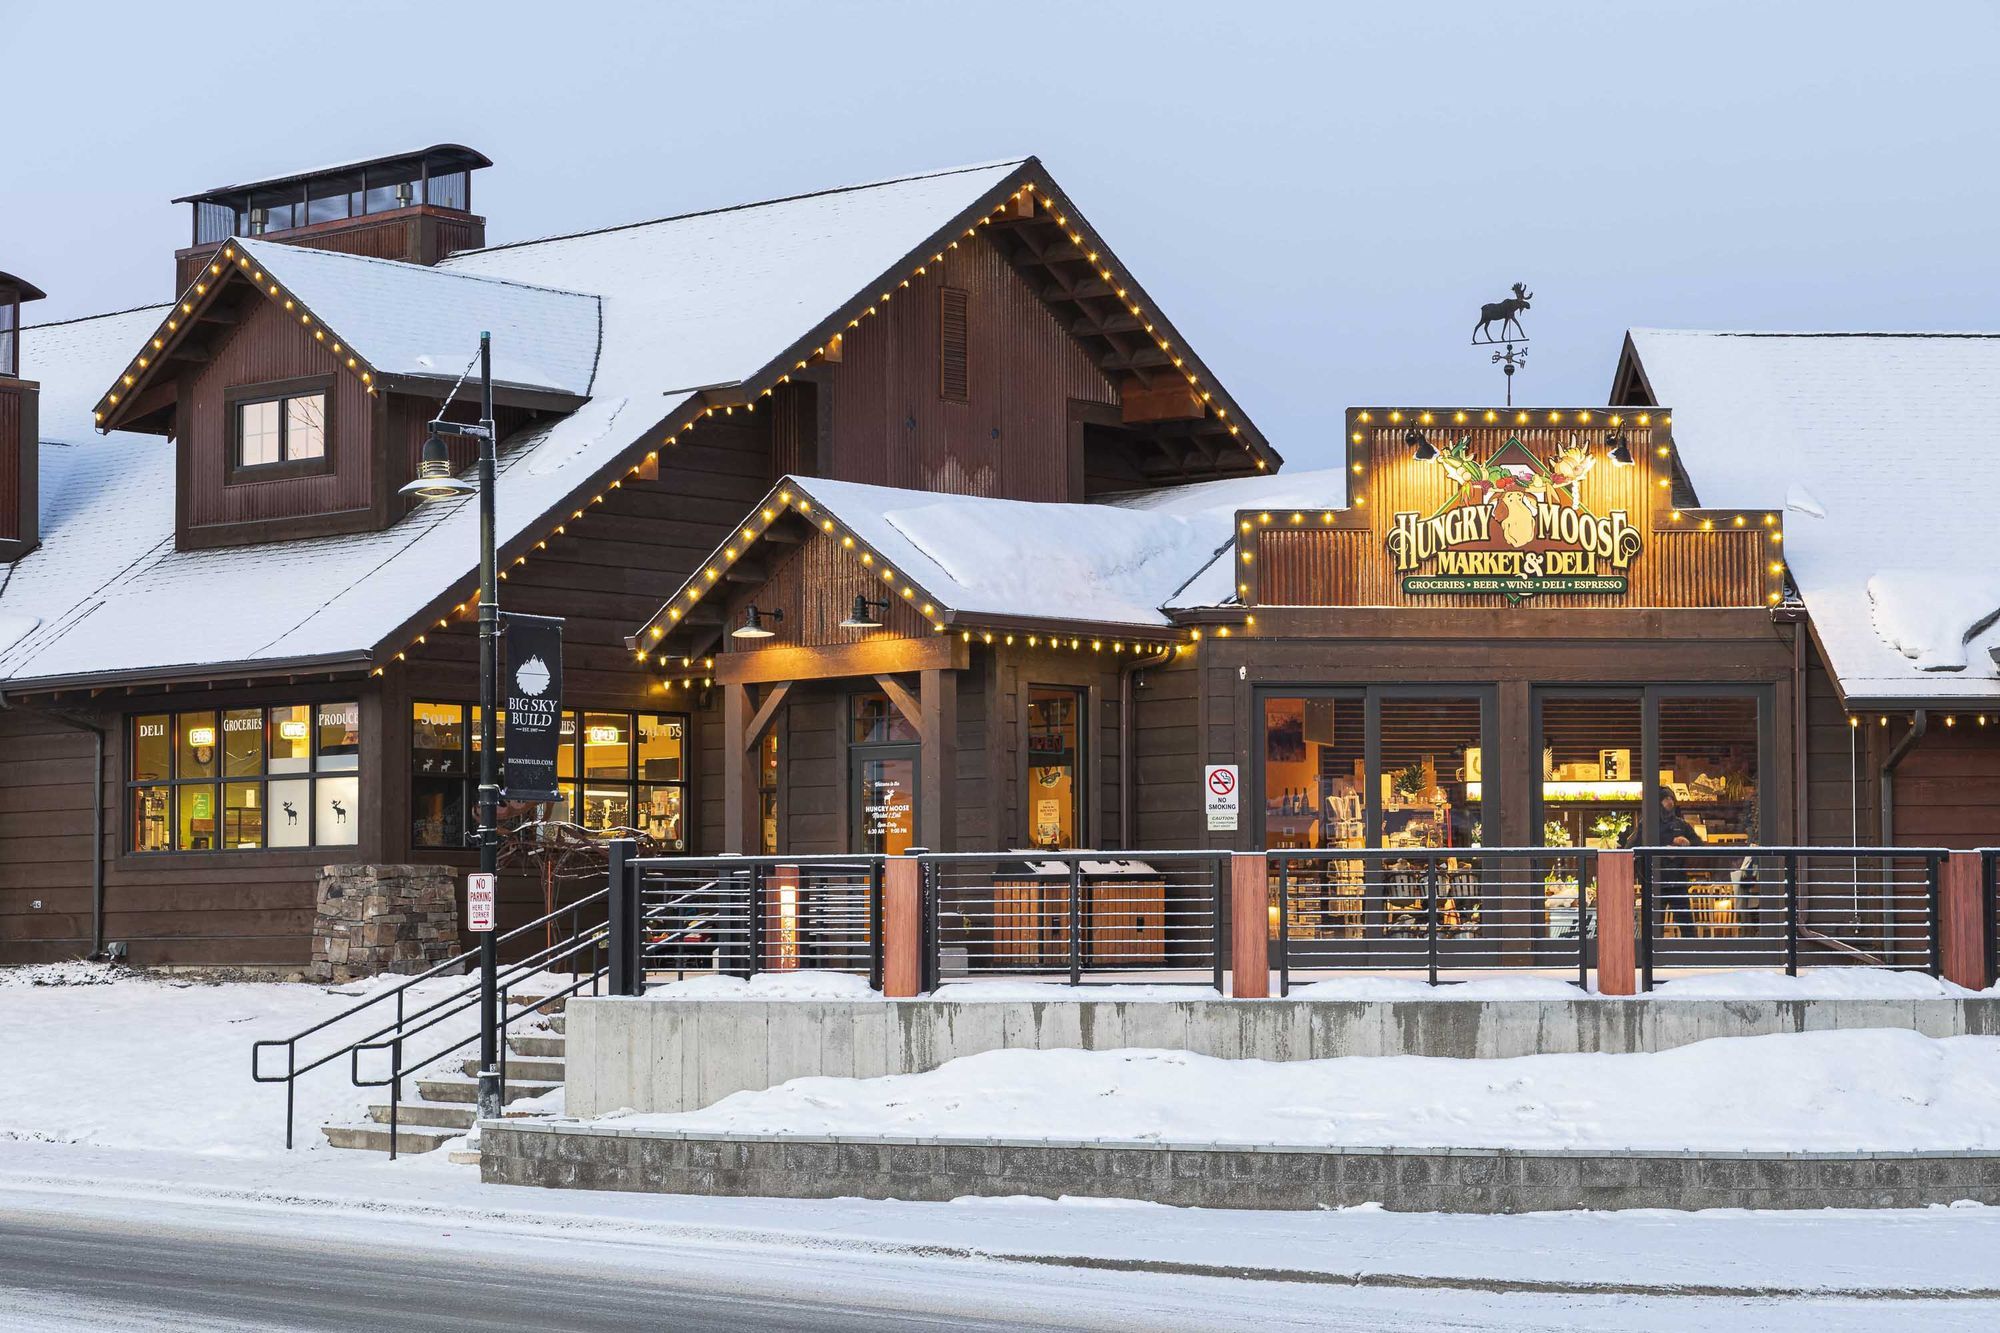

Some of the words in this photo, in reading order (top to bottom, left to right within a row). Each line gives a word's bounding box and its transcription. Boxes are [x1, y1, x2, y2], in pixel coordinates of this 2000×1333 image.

[1389, 505, 1493, 570] HUNGRY
[1537, 503, 1640, 568] MOOSE
[1436, 551, 1524, 575] MARKET
[1545, 551, 1596, 575] DELI
[1408, 580, 1465, 589] GROCERIES
[1473, 580, 1499, 589] BEER
[1506, 580, 1534, 589] WINE
[1542, 580, 1566, 589] DELI
[1574, 580, 1622, 589] ESPRESSO
[508, 697, 529, 711] BIG
[530, 698, 558, 712] SKY
[223, 718, 262, 731] GROCERIES
[318, 712, 359, 726] PRODUCE
[421, 712, 456, 726] SOUP
[512, 712, 553, 726] BUILD
[140, 724, 164, 737] DELI
[508, 757, 554, 766] BIGSKYBUILD.COM
[476, 878, 485, 889] NO
[470, 891, 491, 902] PARKING
